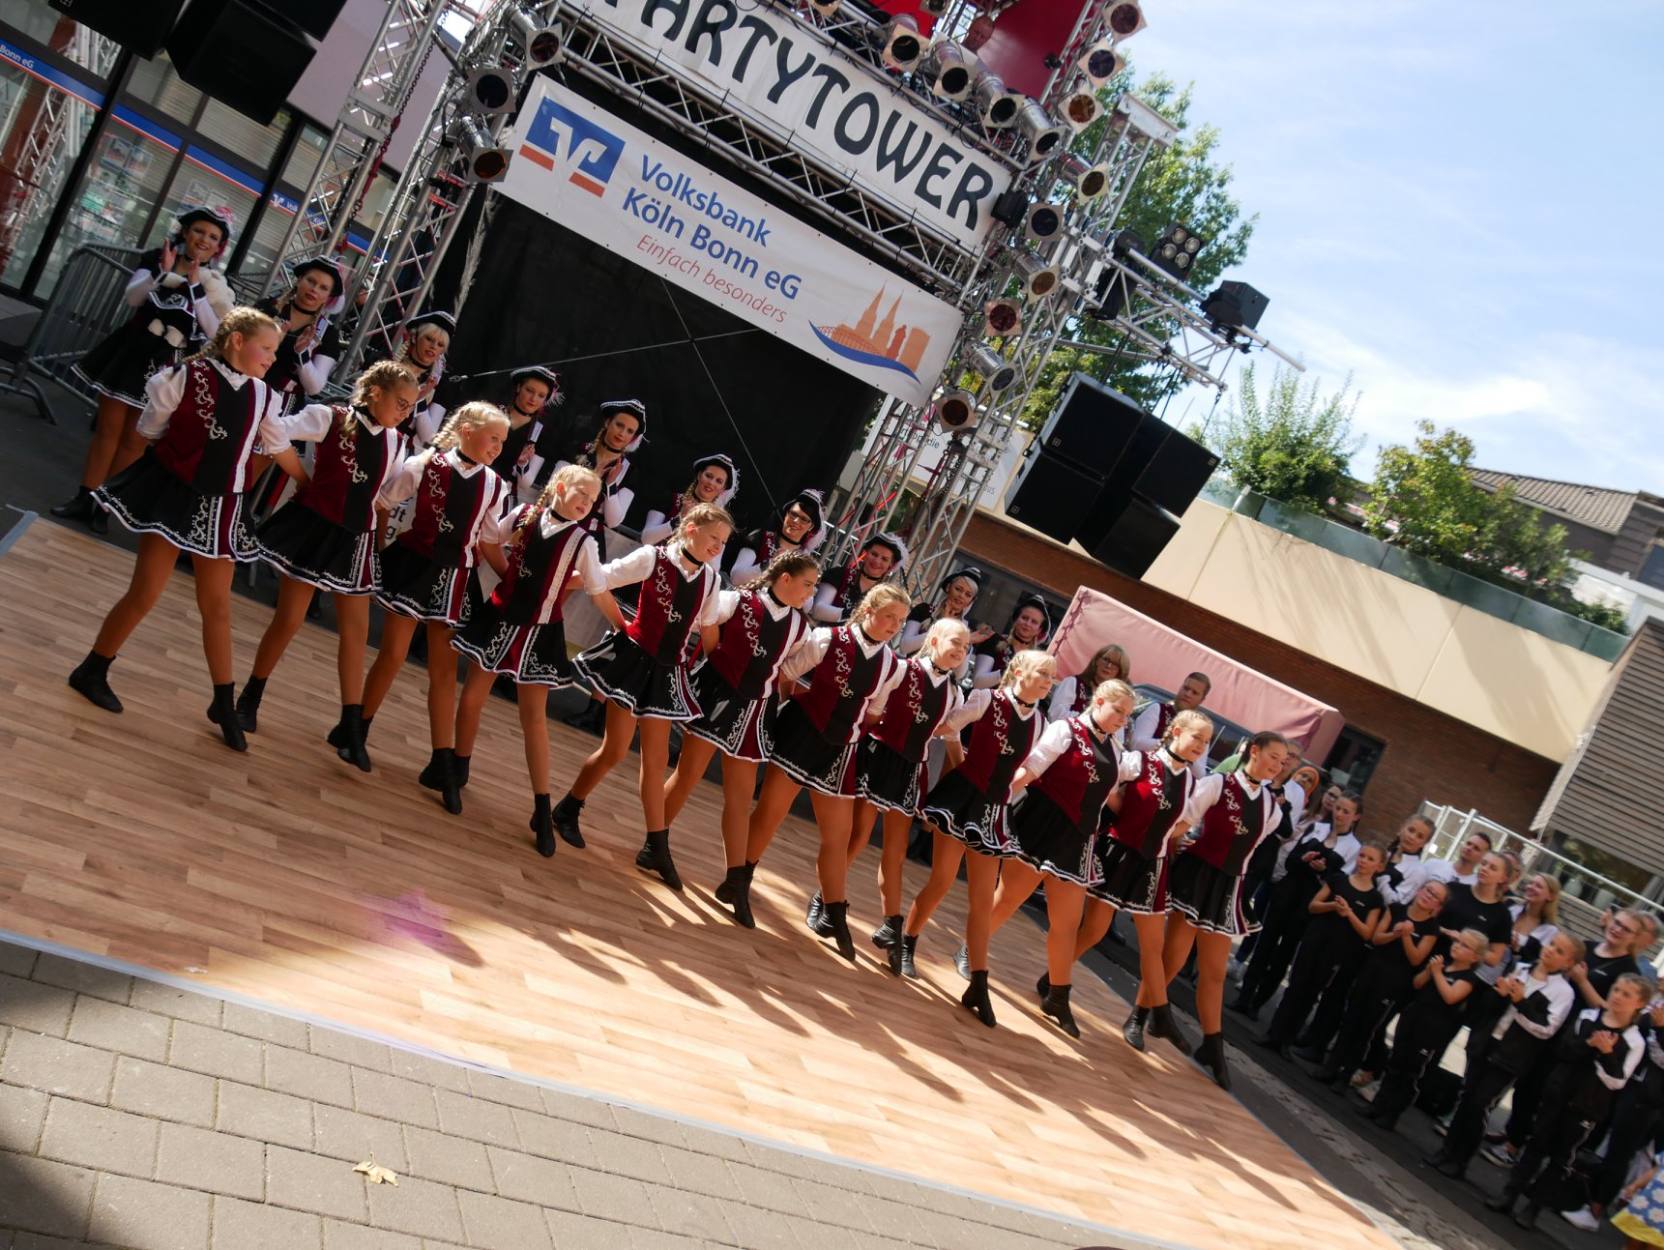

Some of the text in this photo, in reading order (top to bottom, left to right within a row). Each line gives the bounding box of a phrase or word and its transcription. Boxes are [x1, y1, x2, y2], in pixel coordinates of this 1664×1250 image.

[605, 0, 993, 231] ARTYTOWER
[622, 187, 802, 300] Köln Bonn eG
[641, 154, 772, 248] Volksbank
[636, 234, 787, 323] Einfach besonders
